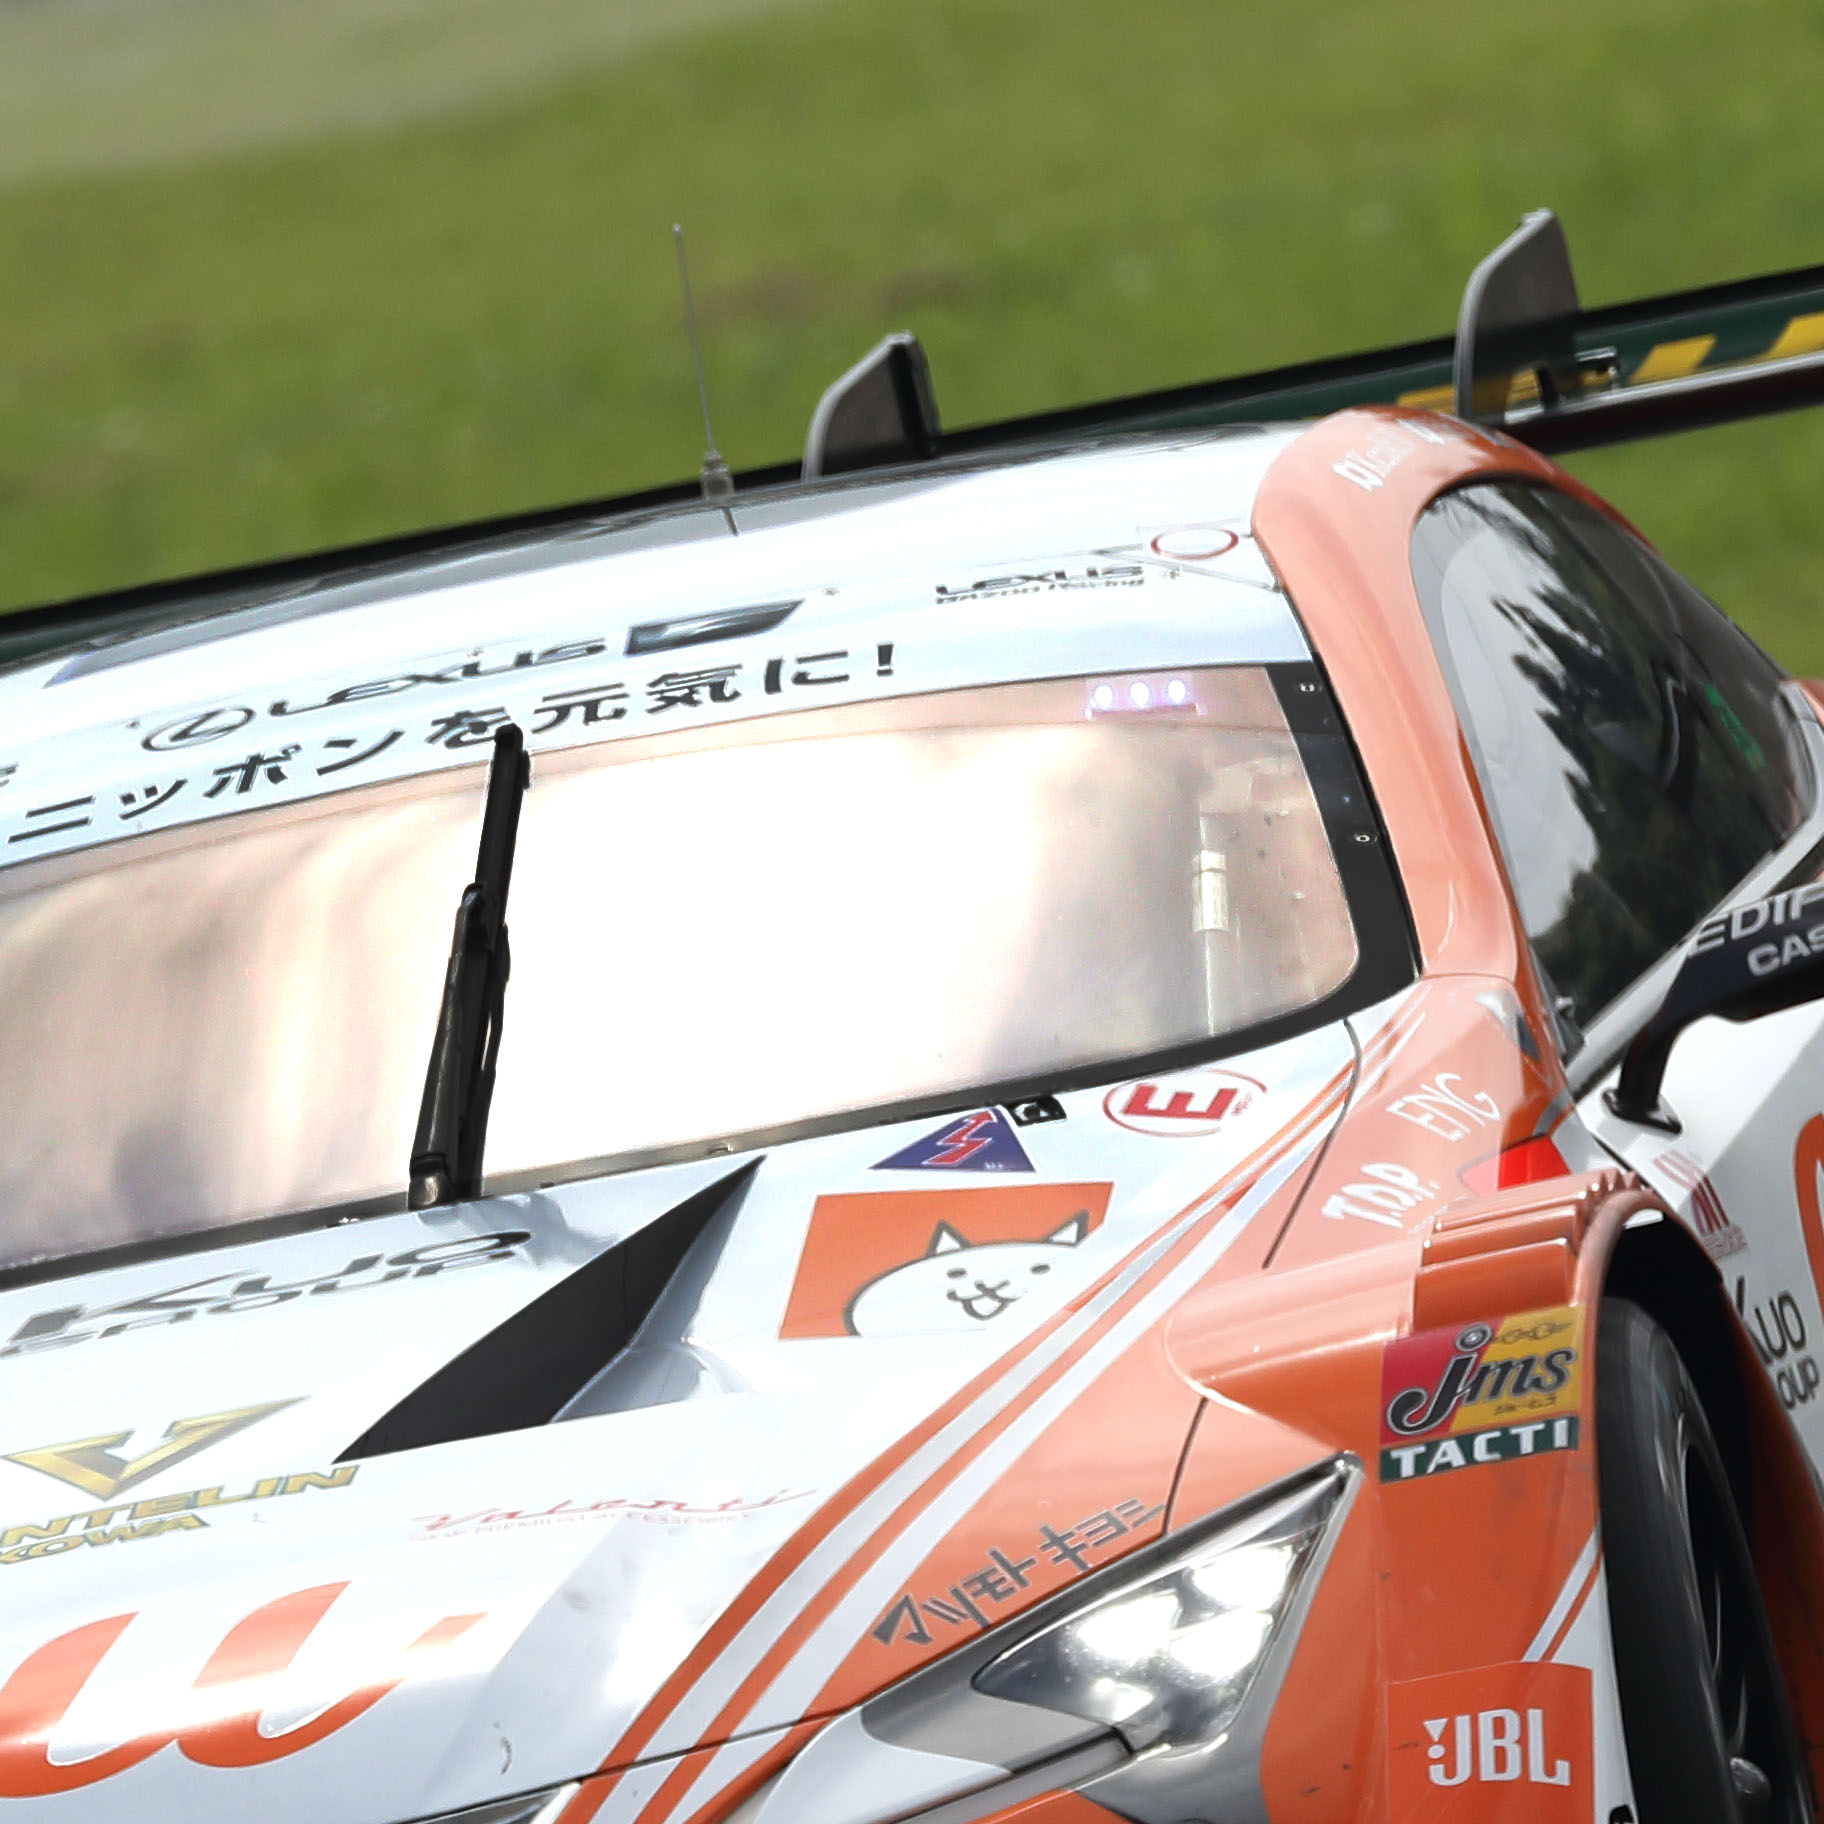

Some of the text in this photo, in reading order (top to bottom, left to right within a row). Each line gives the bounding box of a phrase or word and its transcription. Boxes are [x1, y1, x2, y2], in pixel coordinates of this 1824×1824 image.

[272, 636, 606, 717] LEXUS
[1385, 1071, 1503, 1145] ENG
[1385, 1322, 1577, 1436] jms
[1776, 1356, 1821, 1410] OUP
[1389, 1418, 1570, 1479] TACTI
[871, 1497, 1166, 1647] マツモトキヨシ
[1423, 1707, 1572, 1787] JBL
